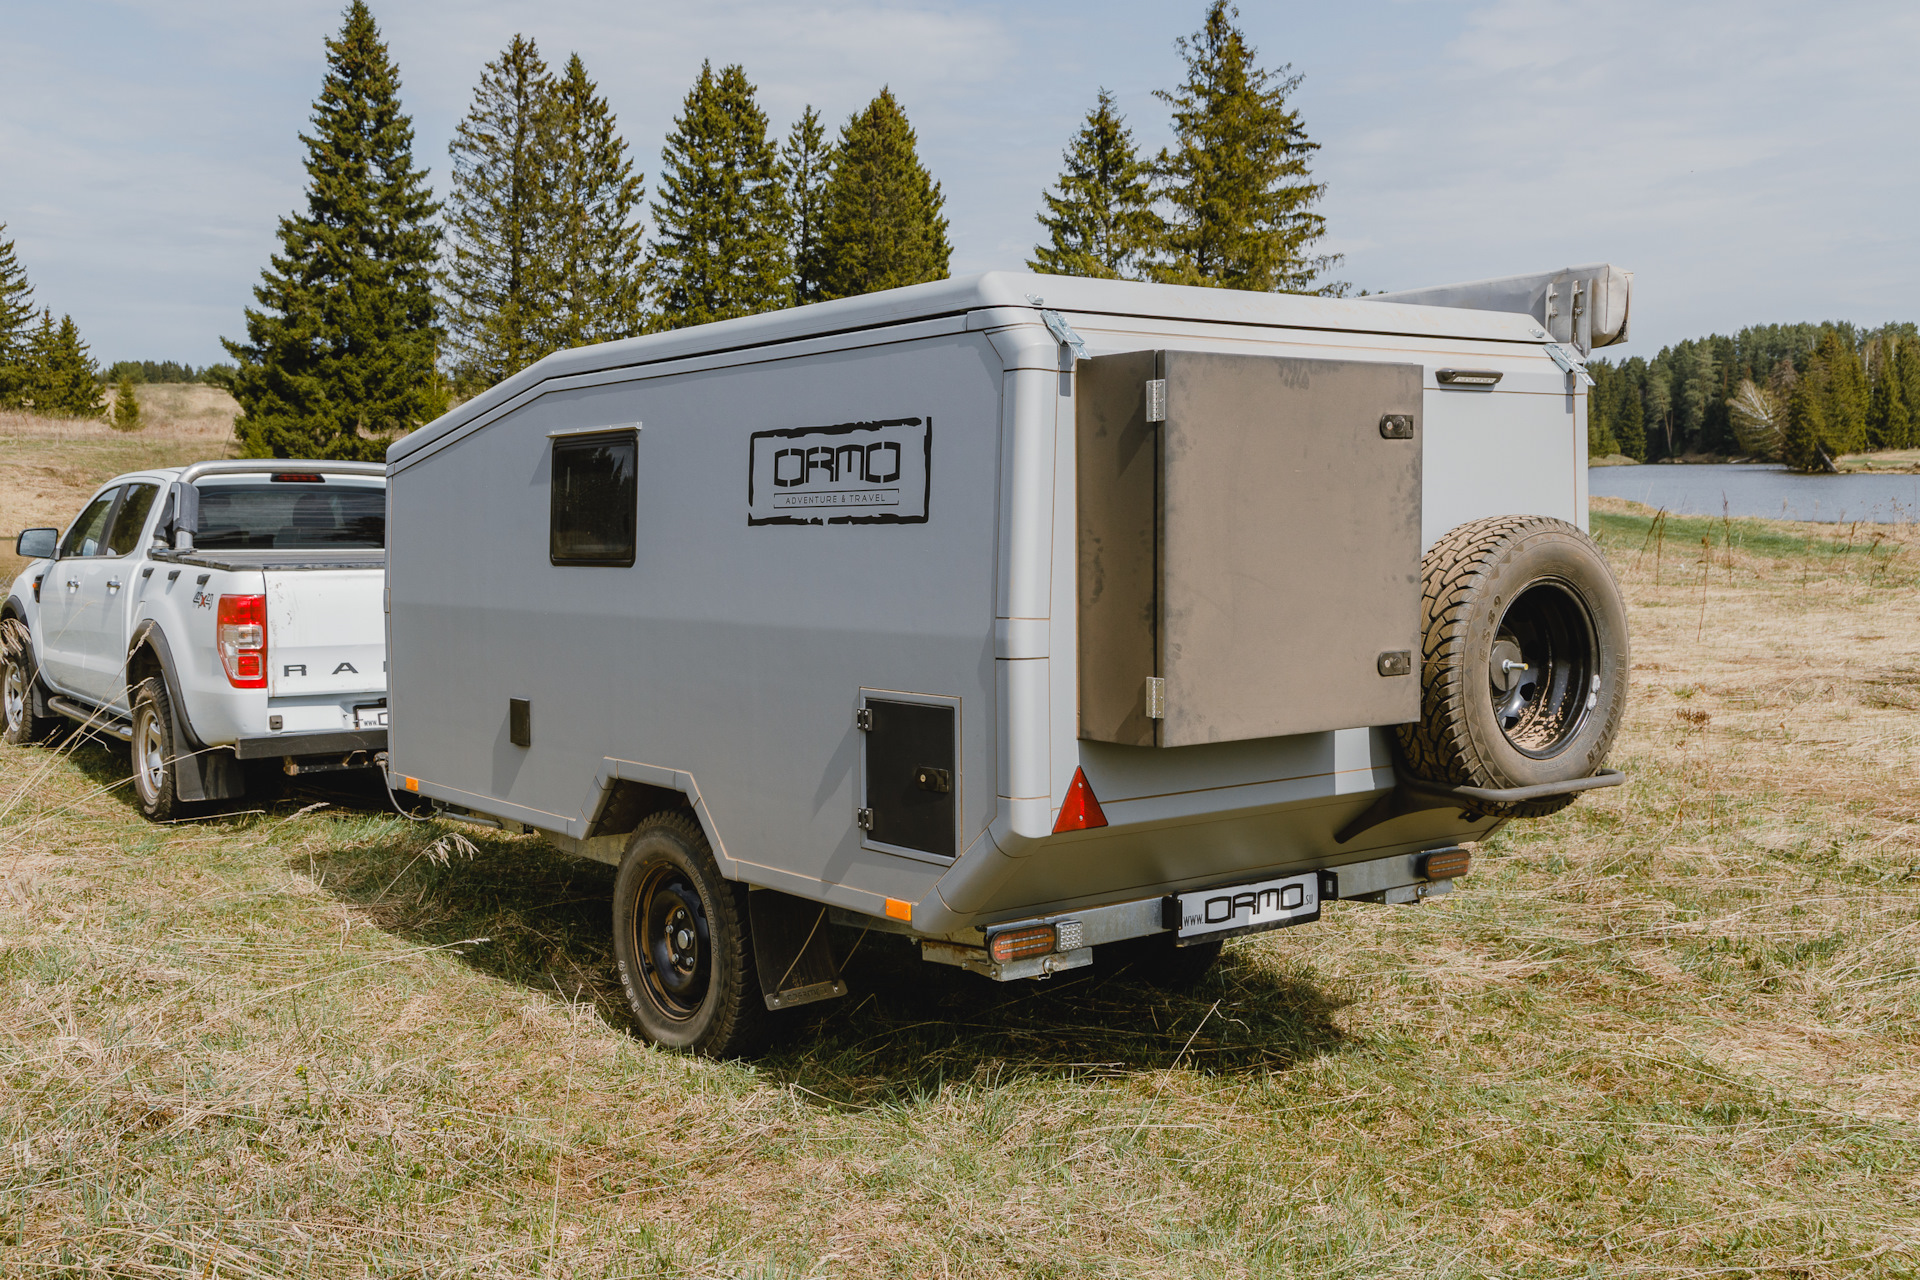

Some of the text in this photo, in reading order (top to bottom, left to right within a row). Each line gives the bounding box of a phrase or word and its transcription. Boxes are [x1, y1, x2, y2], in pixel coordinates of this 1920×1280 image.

[774, 441, 901, 487] ORMO
[785, 494, 886, 505] ADVENTURE & TRAVEL
[284, 662, 386, 677] RA
